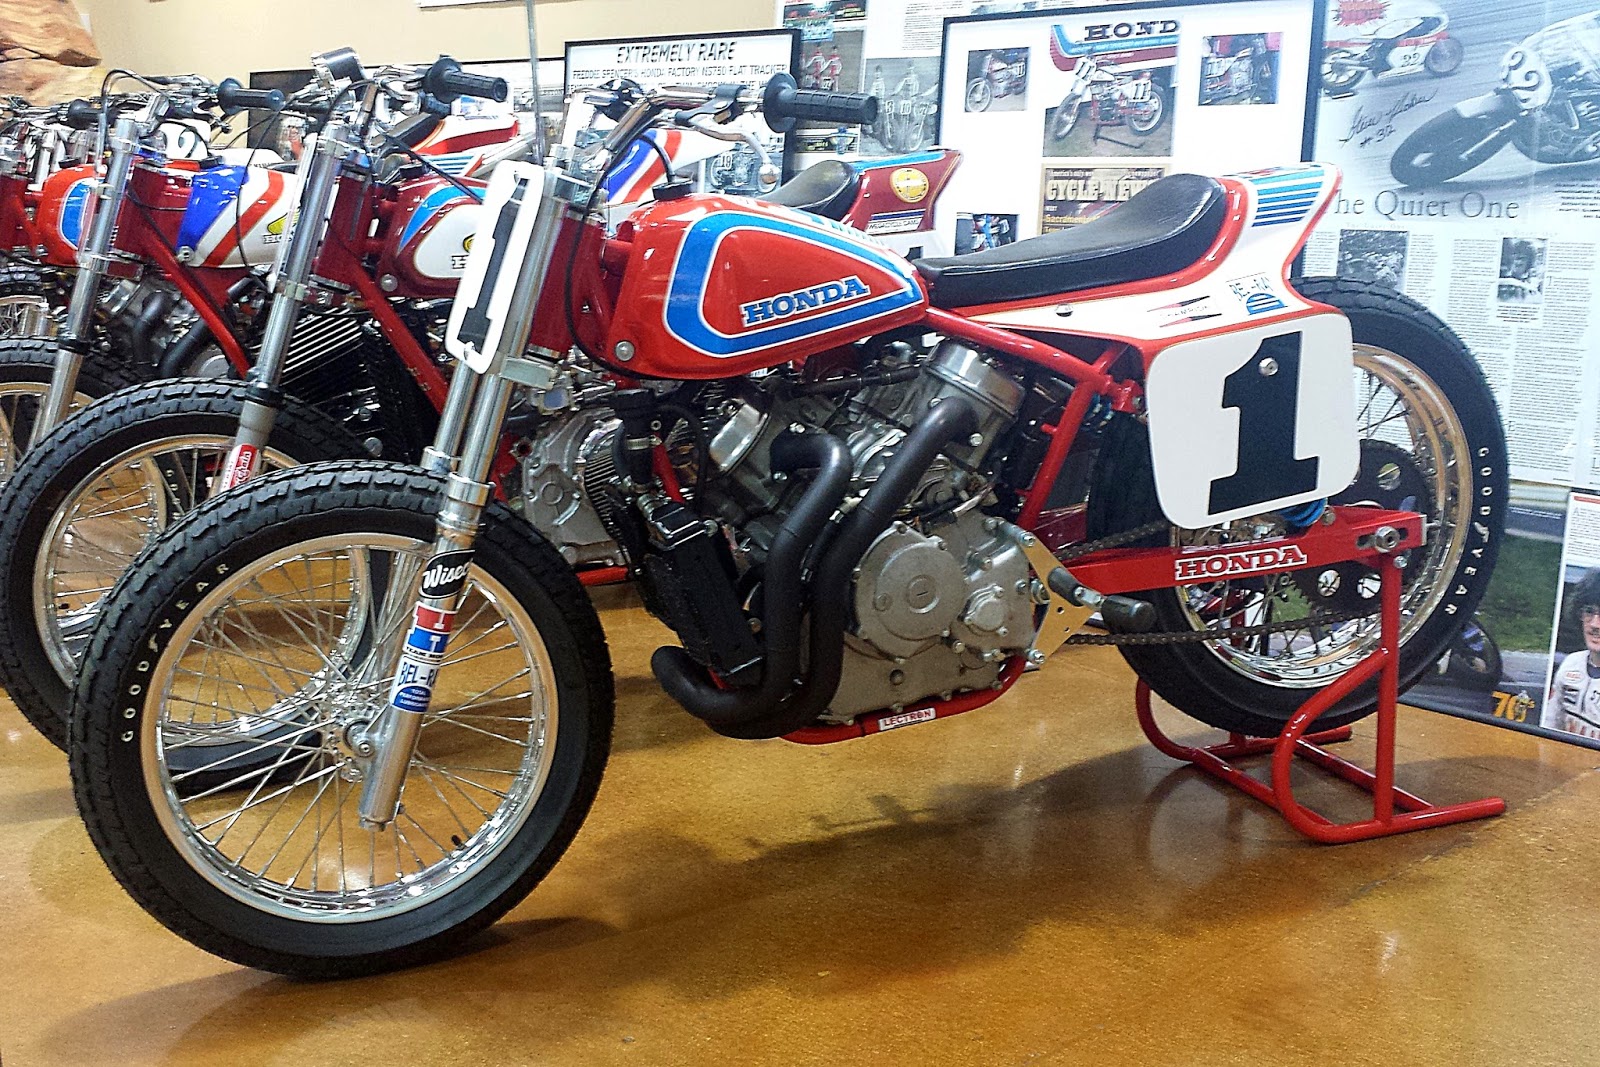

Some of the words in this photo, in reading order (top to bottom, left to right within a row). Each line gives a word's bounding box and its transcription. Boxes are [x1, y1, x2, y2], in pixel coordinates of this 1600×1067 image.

[1084, 20, 1179, 41] HOND
[616, 44, 697, 63] EXTREMELY
[698, 41, 737, 61] RARE
[641, 68, 665, 78] HONDA
[667, 66, 700, 77] FACTORY
[729, 65, 747, 75] FLAT
[750, 64, 787, 74] TRACKER
[1046, 179, 1099, 201] CYCLE
[1100, 179, 1150, 201] NEW
[1334, 188, 1365, 215] he
[1374, 190, 1450, 221] Quiet
[1460, 191, 1519, 219] One
[457, 177, 530, 356] 1
[741, 276, 870, 327] HONDA
[1207, 330, 1320, 515] 1
[422, 562, 471, 589] Wisec
[1175, 545, 1307, 580] HONDA
[398, 661, 438, 687] BEL-R
[884, 709, 931, 726] LECTRON
